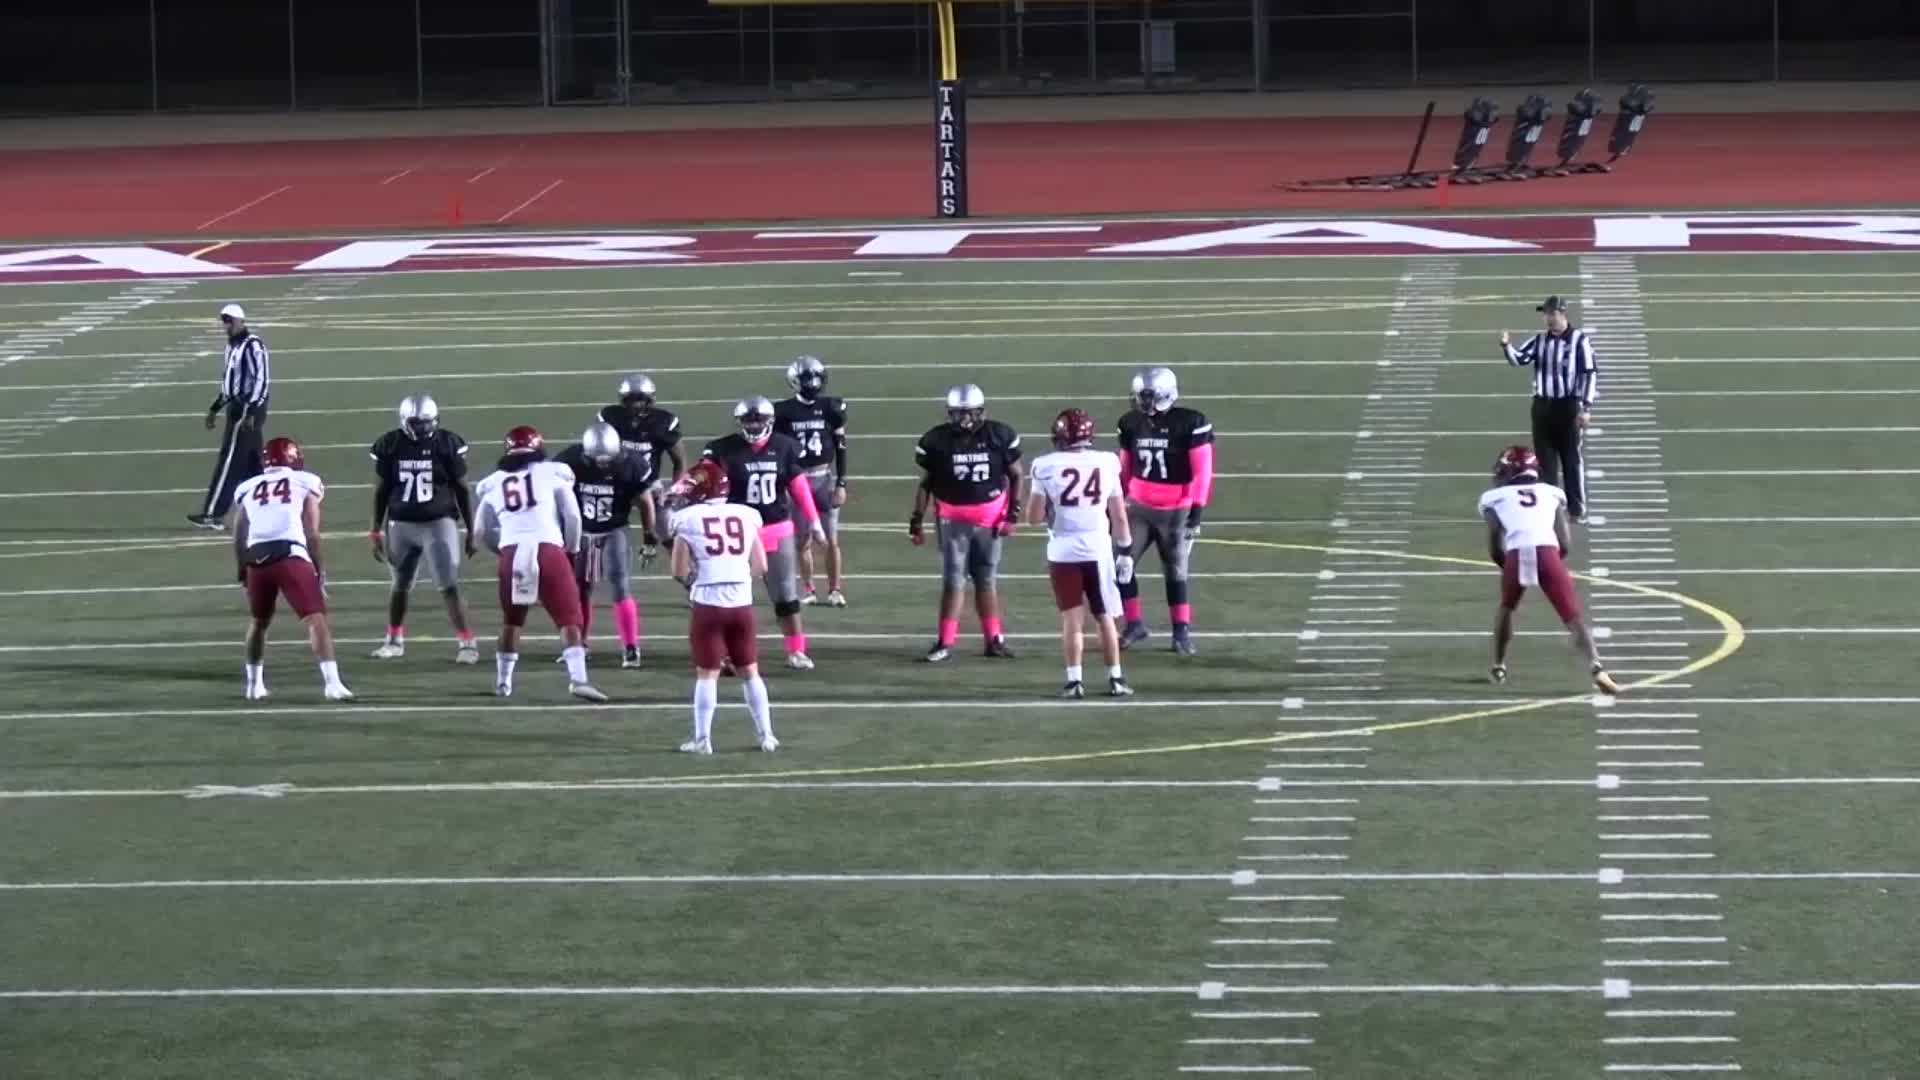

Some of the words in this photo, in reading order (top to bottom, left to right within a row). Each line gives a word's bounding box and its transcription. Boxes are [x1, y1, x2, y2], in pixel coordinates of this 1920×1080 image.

[939, 86, 956, 215] TARTARS
[1138, 449, 1168, 479] 71
[252, 477, 292, 507] 44
[398, 470, 434, 503] 76
[502, 473, 538, 513] 61
[746, 473, 778, 505] 60
[1060, 467, 1102, 507] 24
[702, 516, 745, 556] 59
